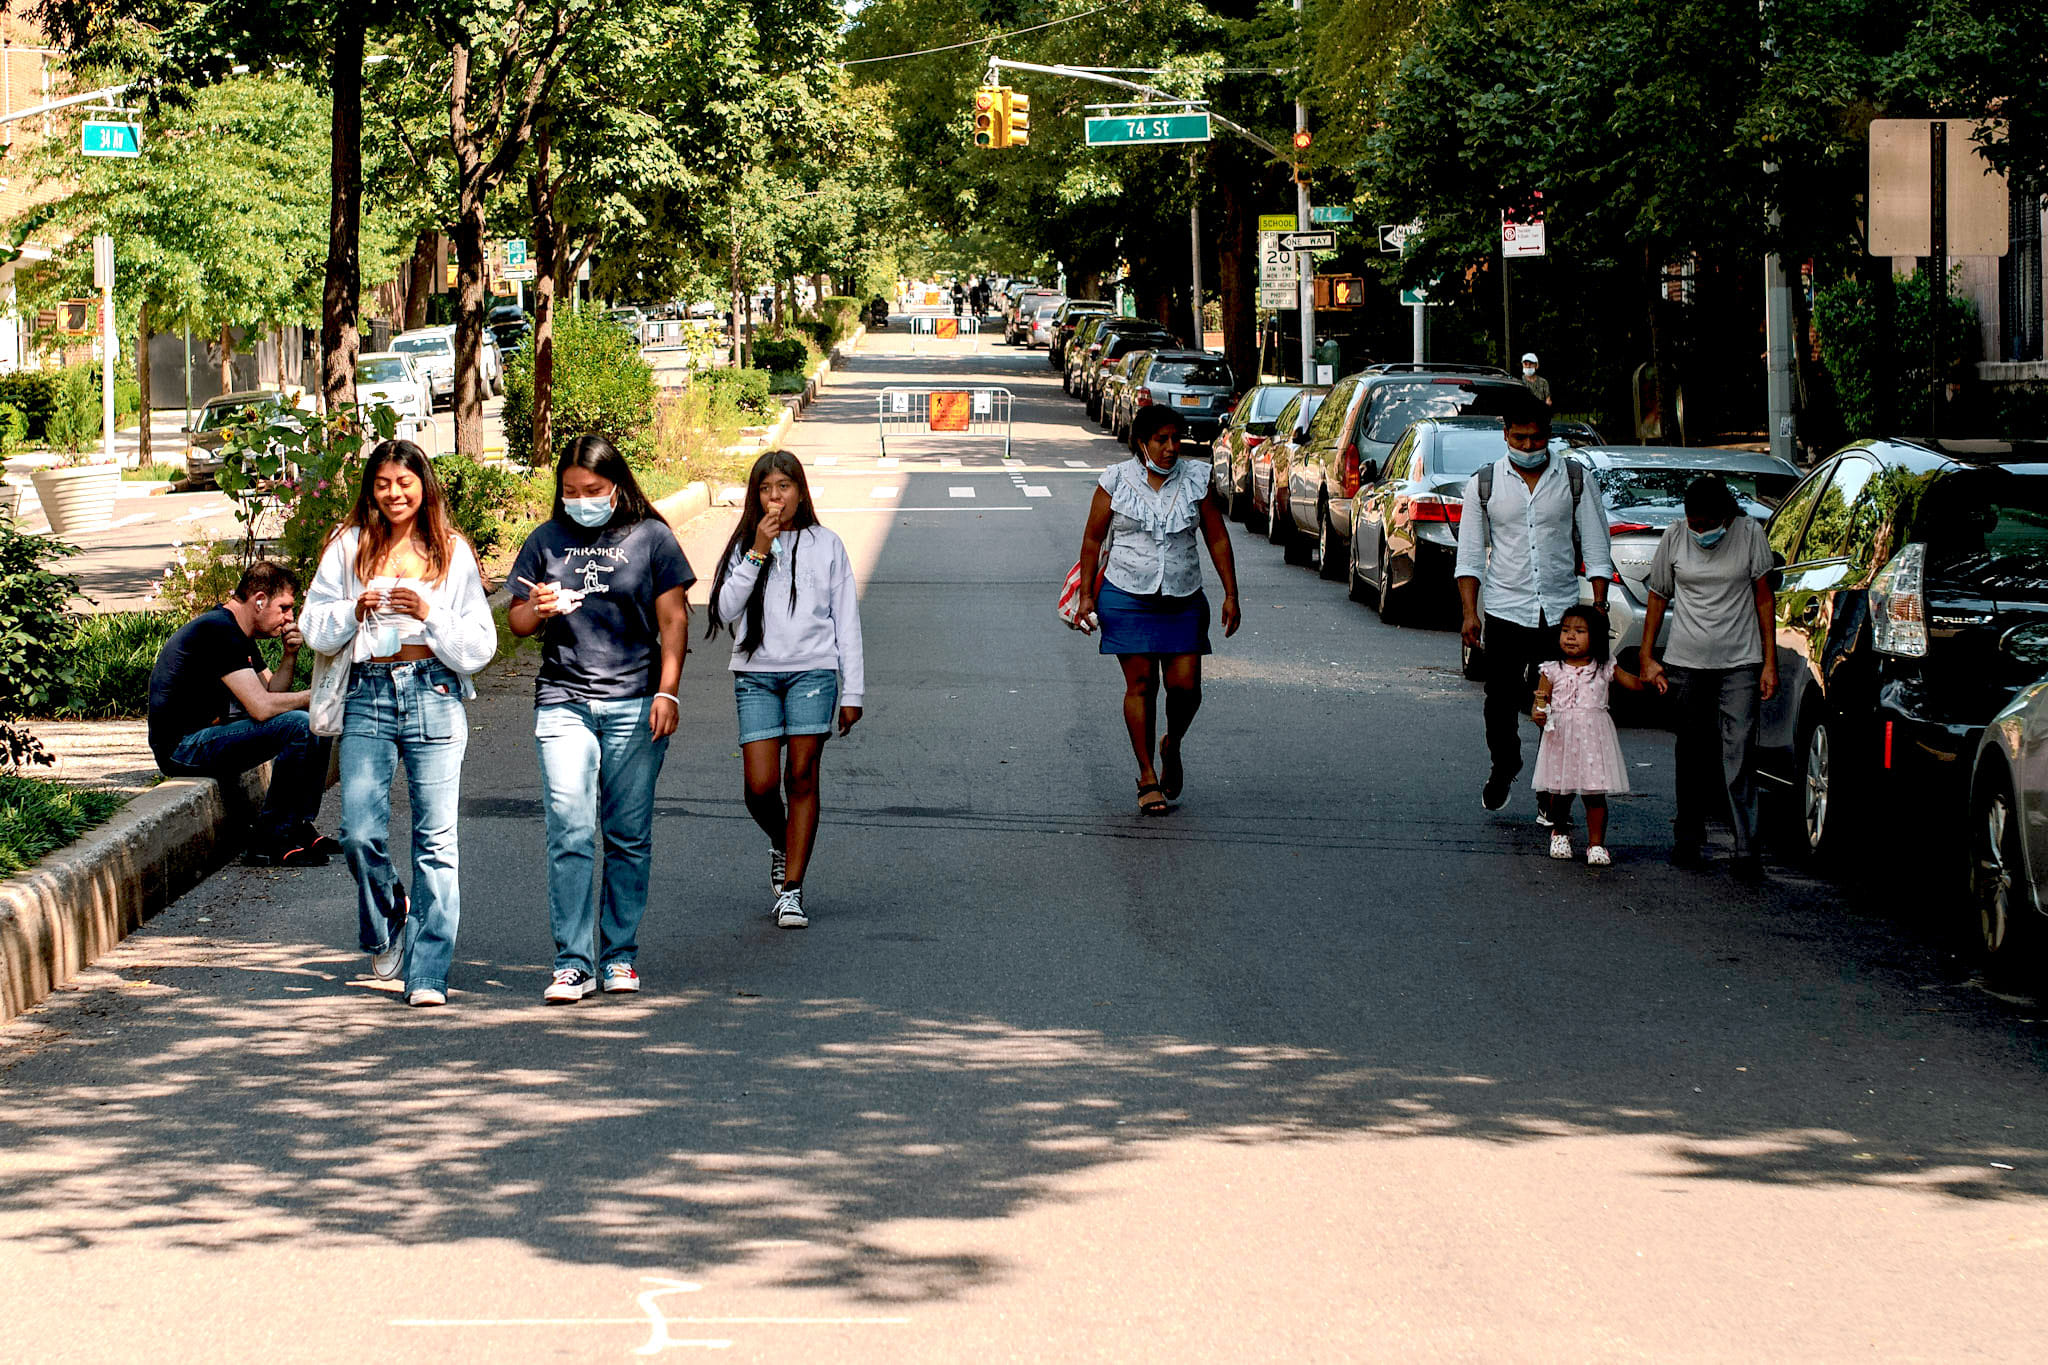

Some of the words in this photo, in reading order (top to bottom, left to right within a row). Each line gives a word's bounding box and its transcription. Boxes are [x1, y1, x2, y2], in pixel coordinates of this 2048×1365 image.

[1126, 121, 1146, 138] 74
[1153, 120, 1170, 137] St
[100, 128, 111, 149] 34
[1263, 219, 1293, 228] SCHOOL
[1286, 238, 1301, 246] ONE
[1310, 237, 1327, 245] WAY
[1267, 250, 1290, 264] 20
[564, 547, 629, 565] THRASHER
